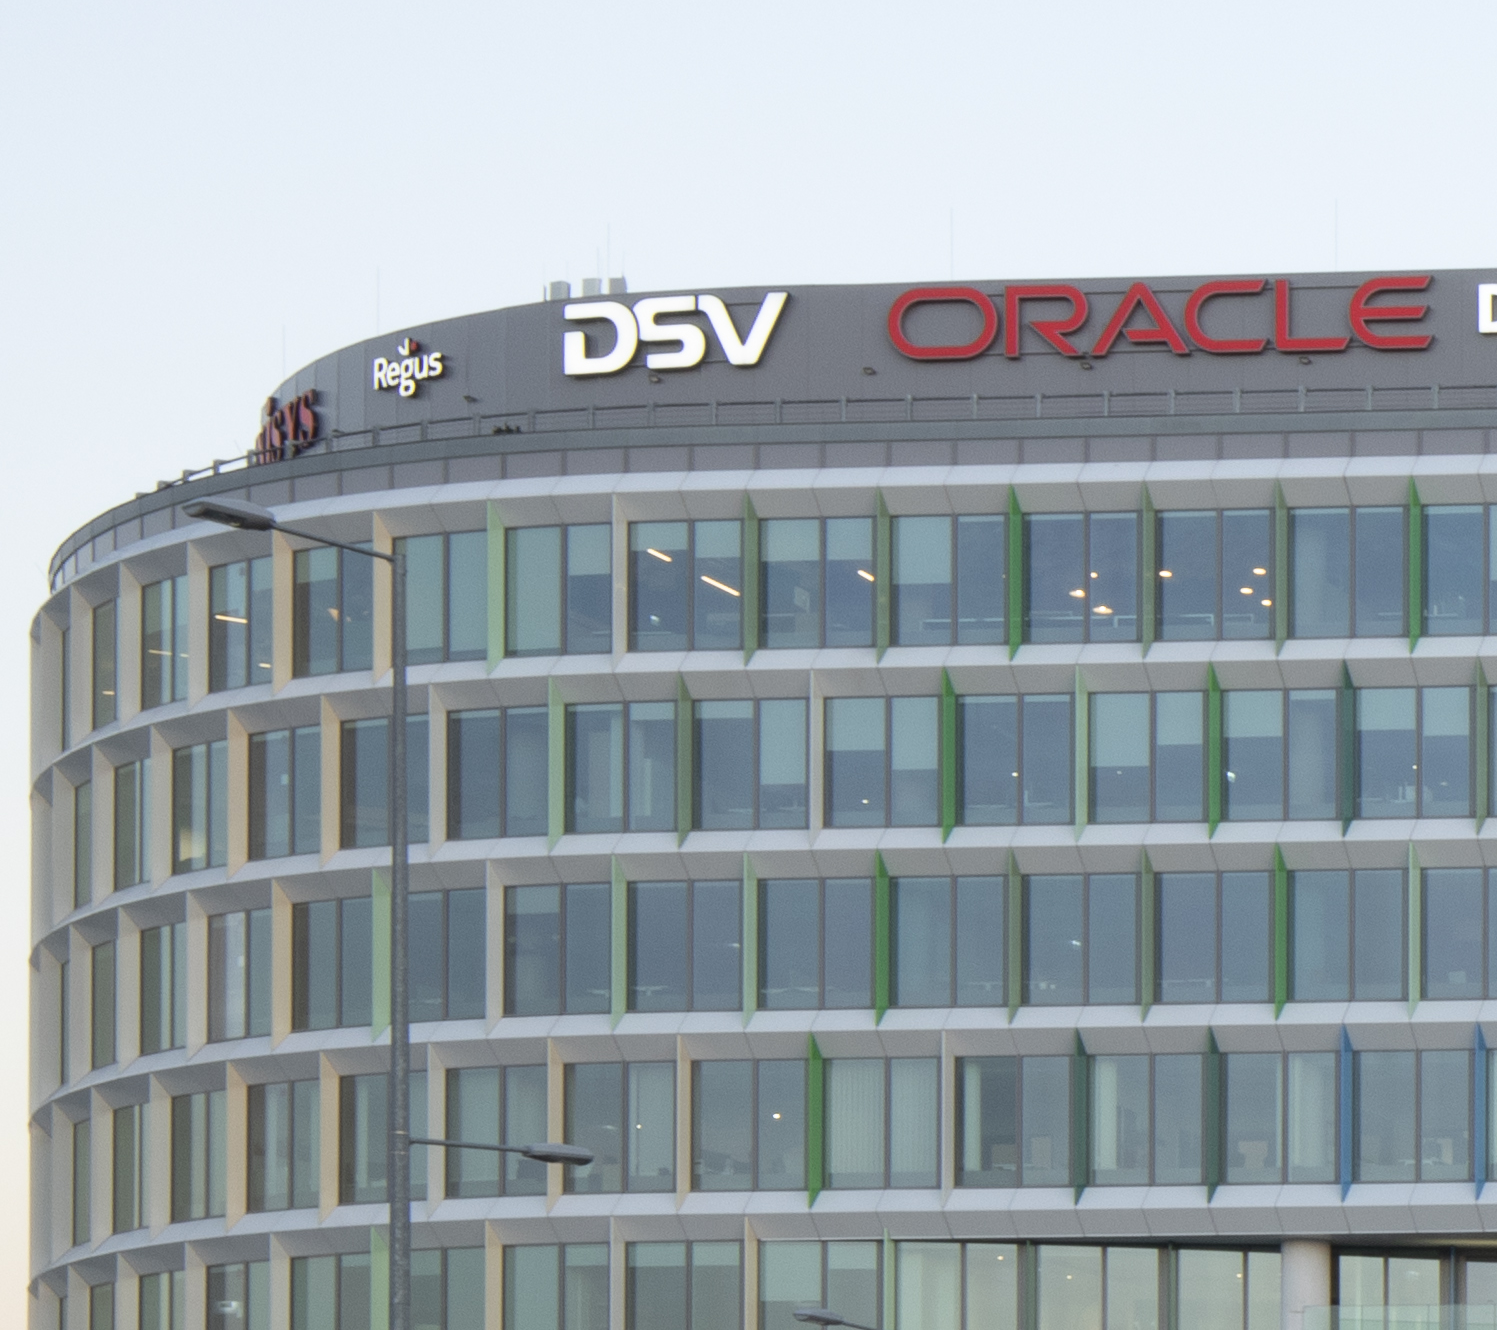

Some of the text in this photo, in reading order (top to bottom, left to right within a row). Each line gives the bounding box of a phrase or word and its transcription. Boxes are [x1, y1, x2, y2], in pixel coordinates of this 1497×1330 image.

[563, 292, 789, 377] DSV
[888, 275, 1434, 360] ORACLE
[373, 352, 443, 397] Regus
